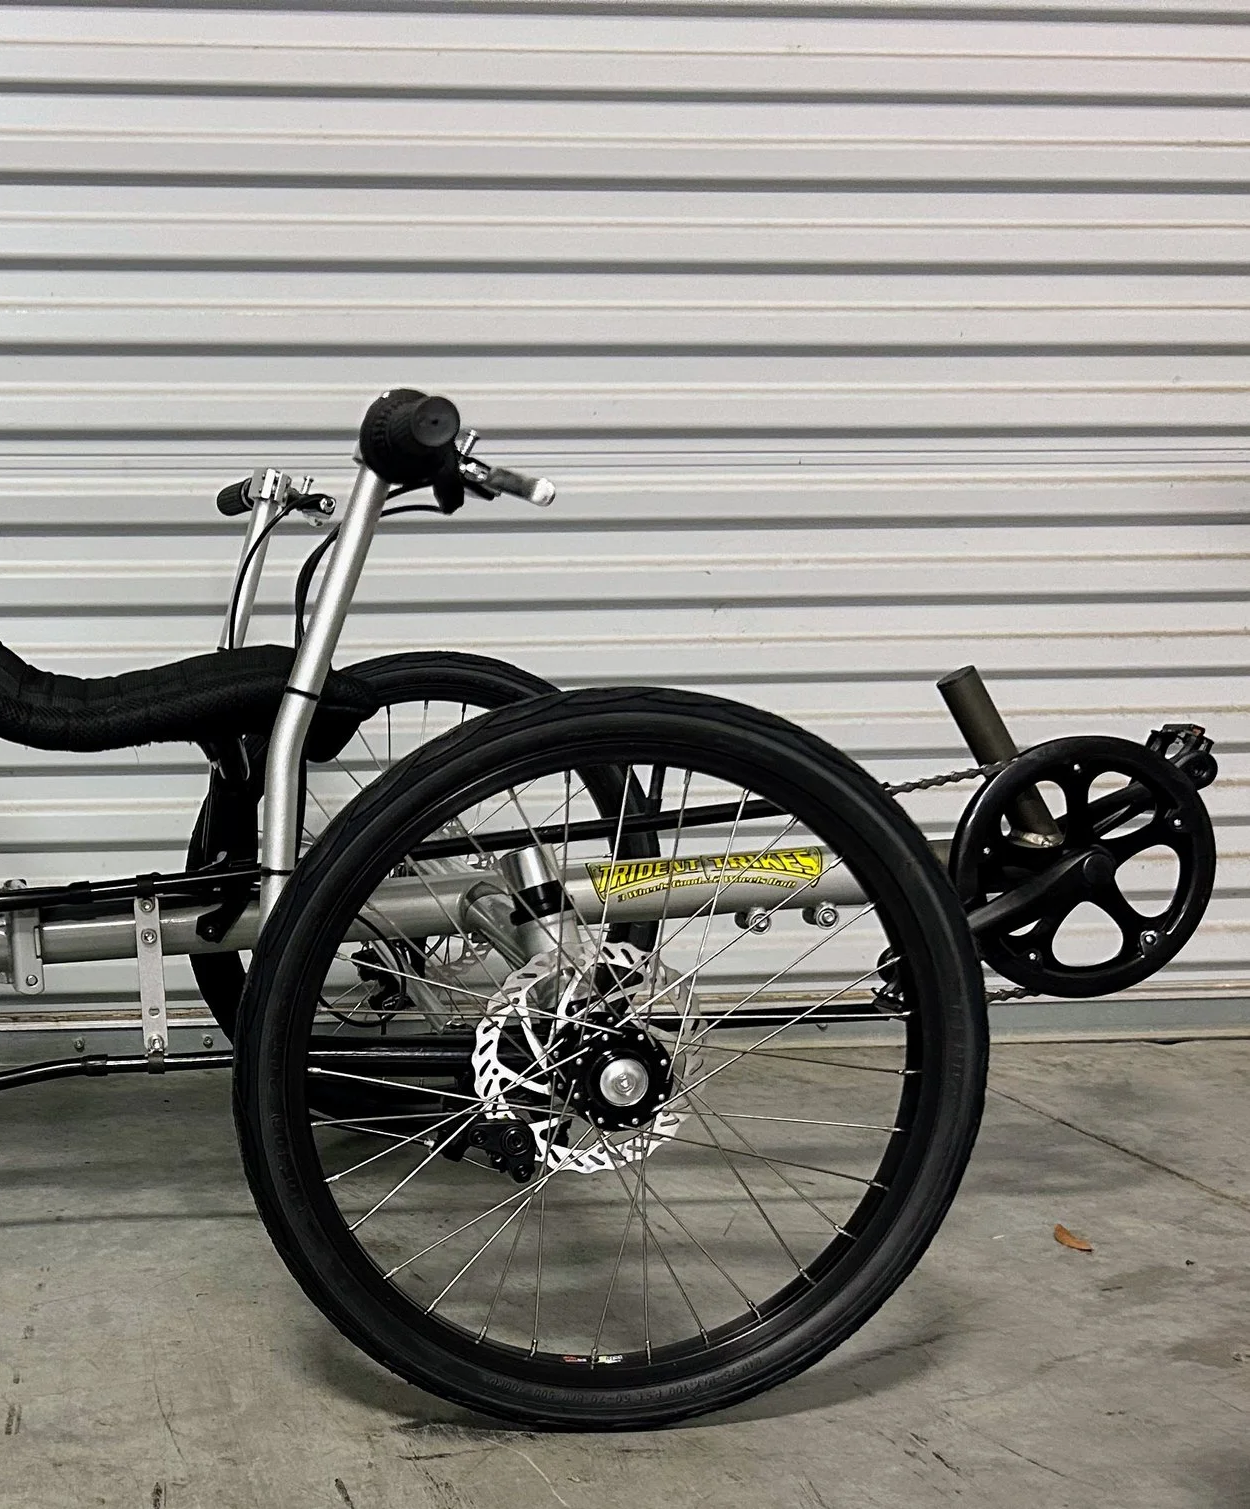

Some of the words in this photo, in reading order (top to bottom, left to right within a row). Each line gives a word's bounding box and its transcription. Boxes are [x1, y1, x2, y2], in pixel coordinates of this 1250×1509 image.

[599, 860, 699, 893] TRIDENT
[709, 851, 819, 876] TRIKES
[628, 882, 669, 898] Wheels
